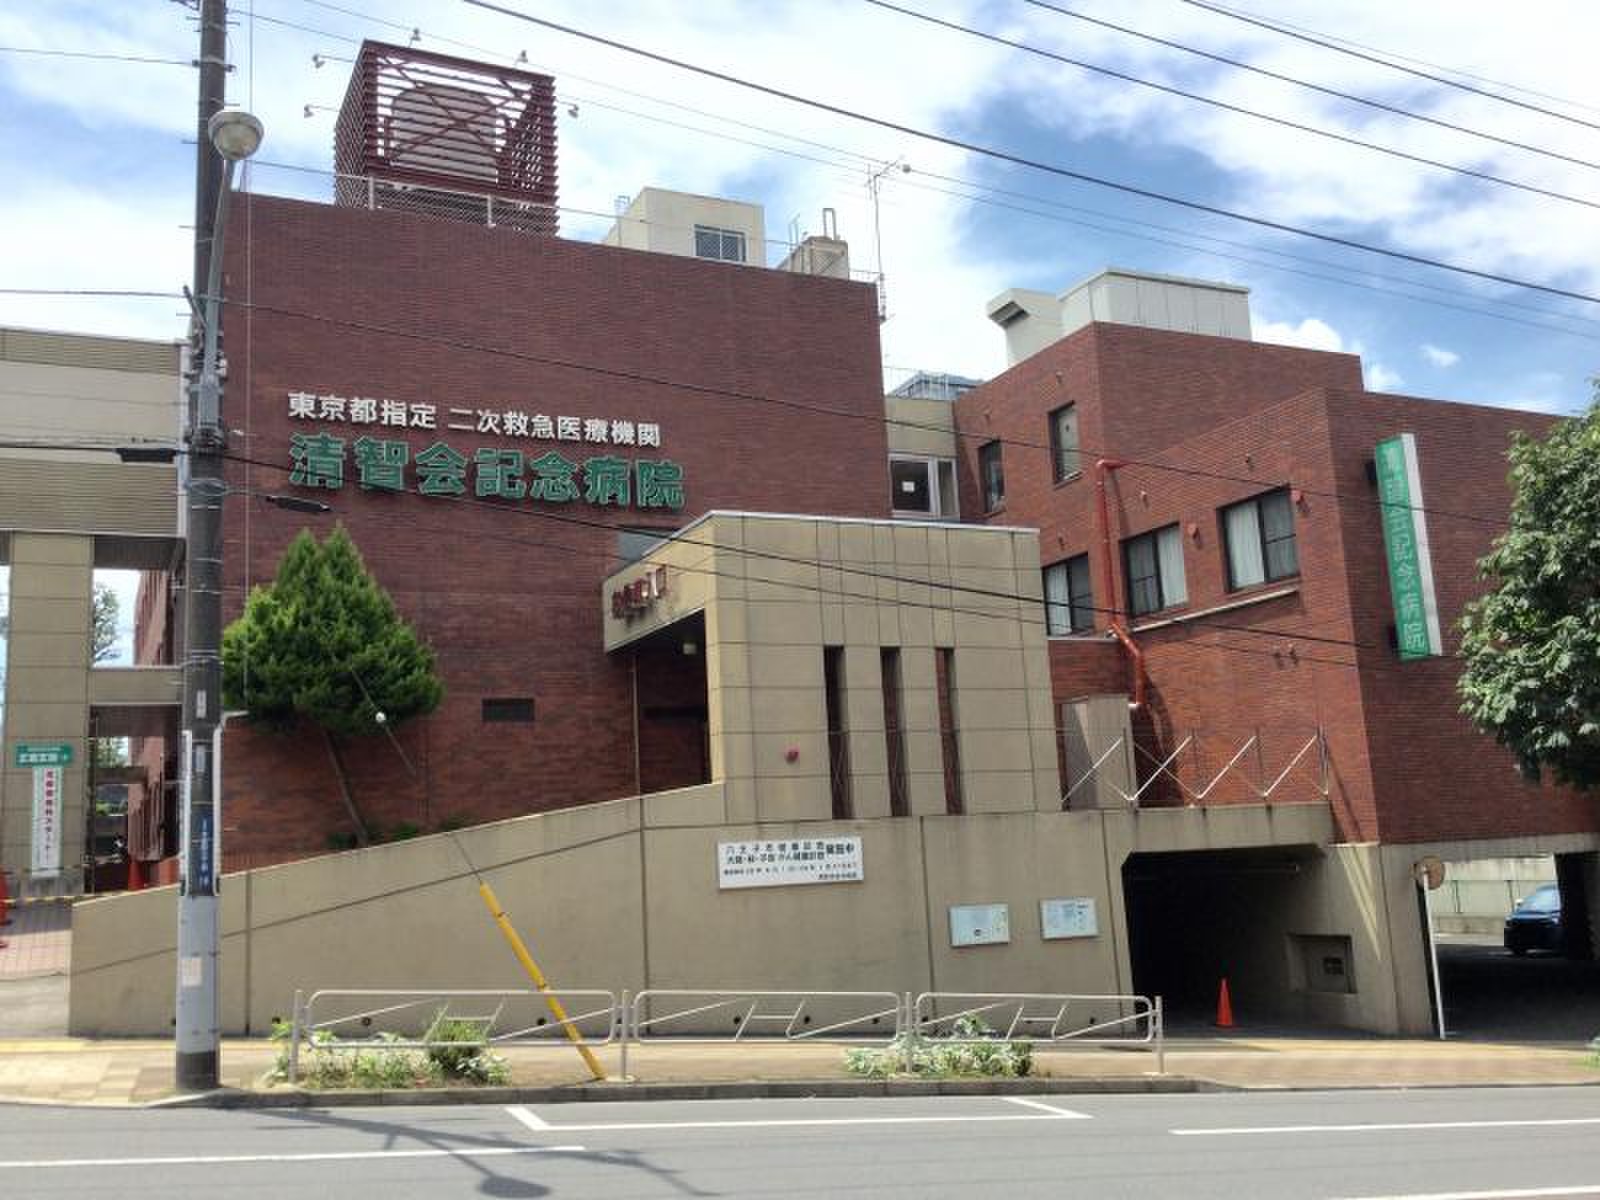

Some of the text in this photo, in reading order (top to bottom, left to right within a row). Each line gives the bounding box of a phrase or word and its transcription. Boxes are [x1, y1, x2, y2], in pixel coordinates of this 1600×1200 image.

[288, 391, 661, 448] 東京都指定 二次救急医療機関
[288, 431, 686, 509] 清智会記念病院
